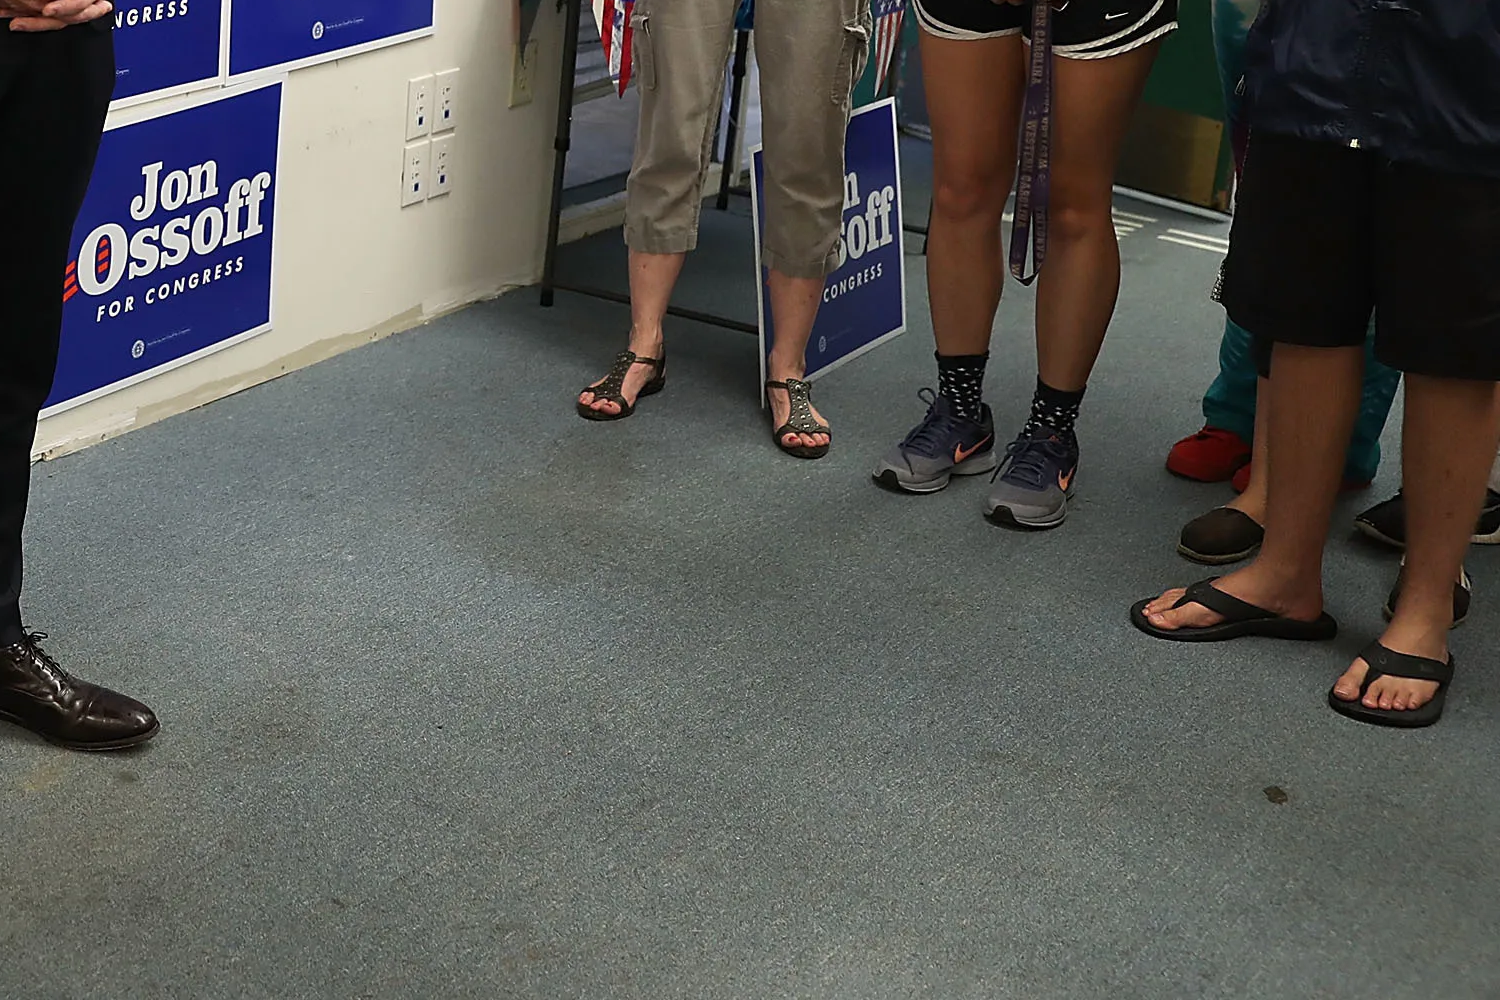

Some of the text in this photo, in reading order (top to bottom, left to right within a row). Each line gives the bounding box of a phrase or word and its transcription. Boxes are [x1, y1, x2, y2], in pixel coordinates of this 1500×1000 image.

[130, 159, 219, 221] Jon
[77, 171, 271, 296] Ossoff
[96, 256, 244, 322] FOR CONGRESS
[823, 262, 883, 303] CONGRESS
